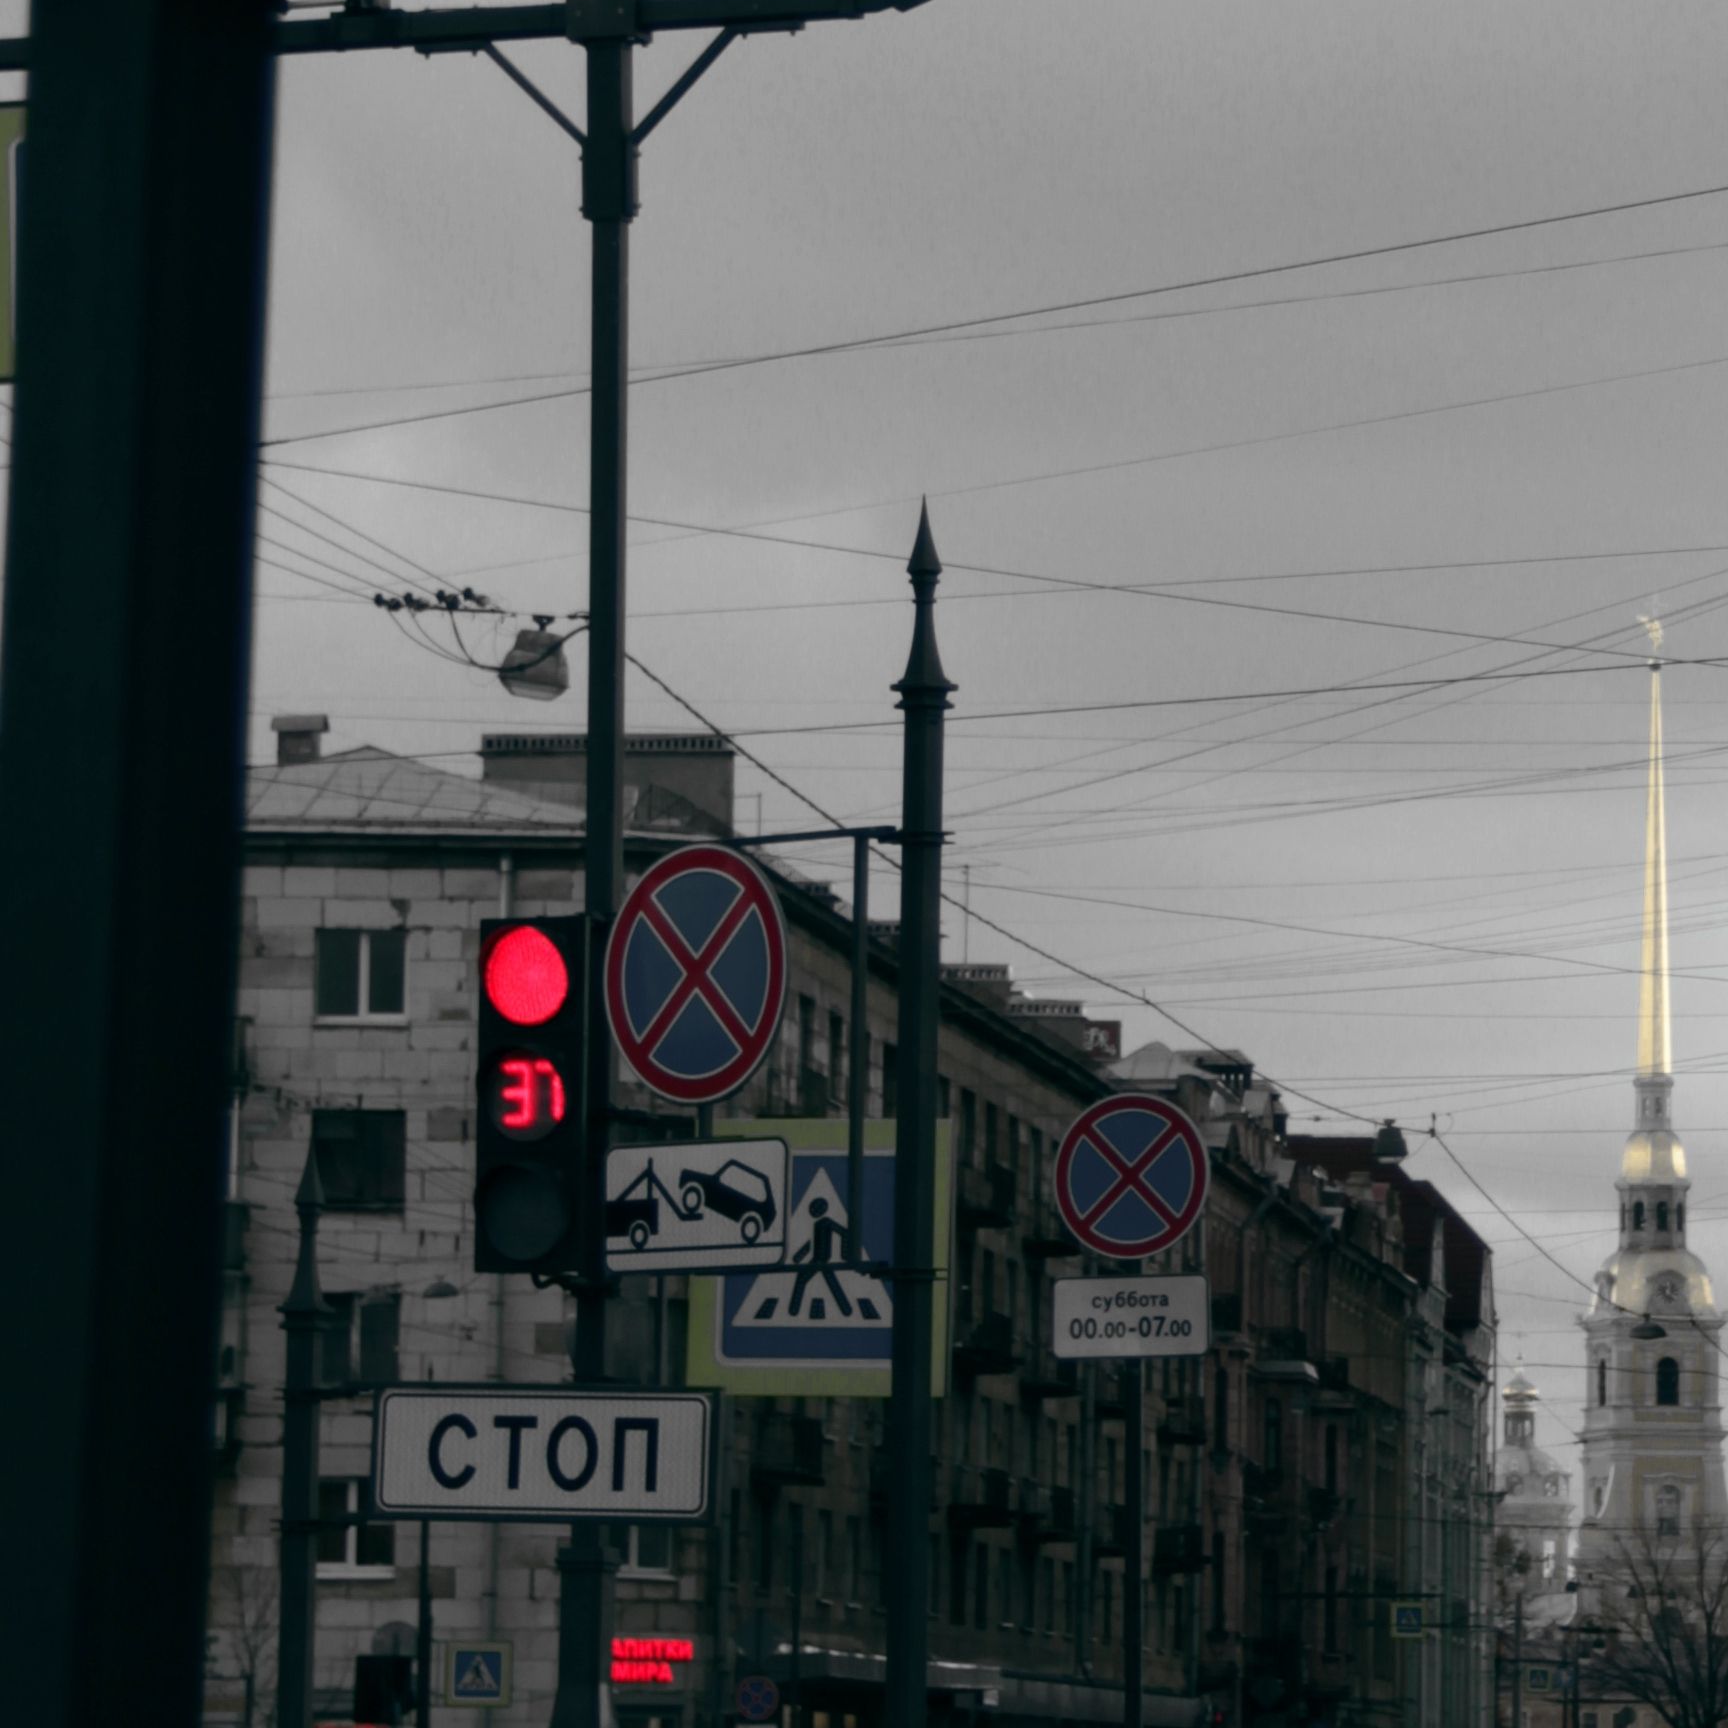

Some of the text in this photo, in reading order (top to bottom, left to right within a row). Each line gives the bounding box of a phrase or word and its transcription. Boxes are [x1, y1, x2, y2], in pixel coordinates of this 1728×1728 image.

[1091, 1290, 1169, 1313] суббота
[1069, 1316, 1192, 1340] 00.00-07.00
[428, 1412, 659, 1492] СТОП
